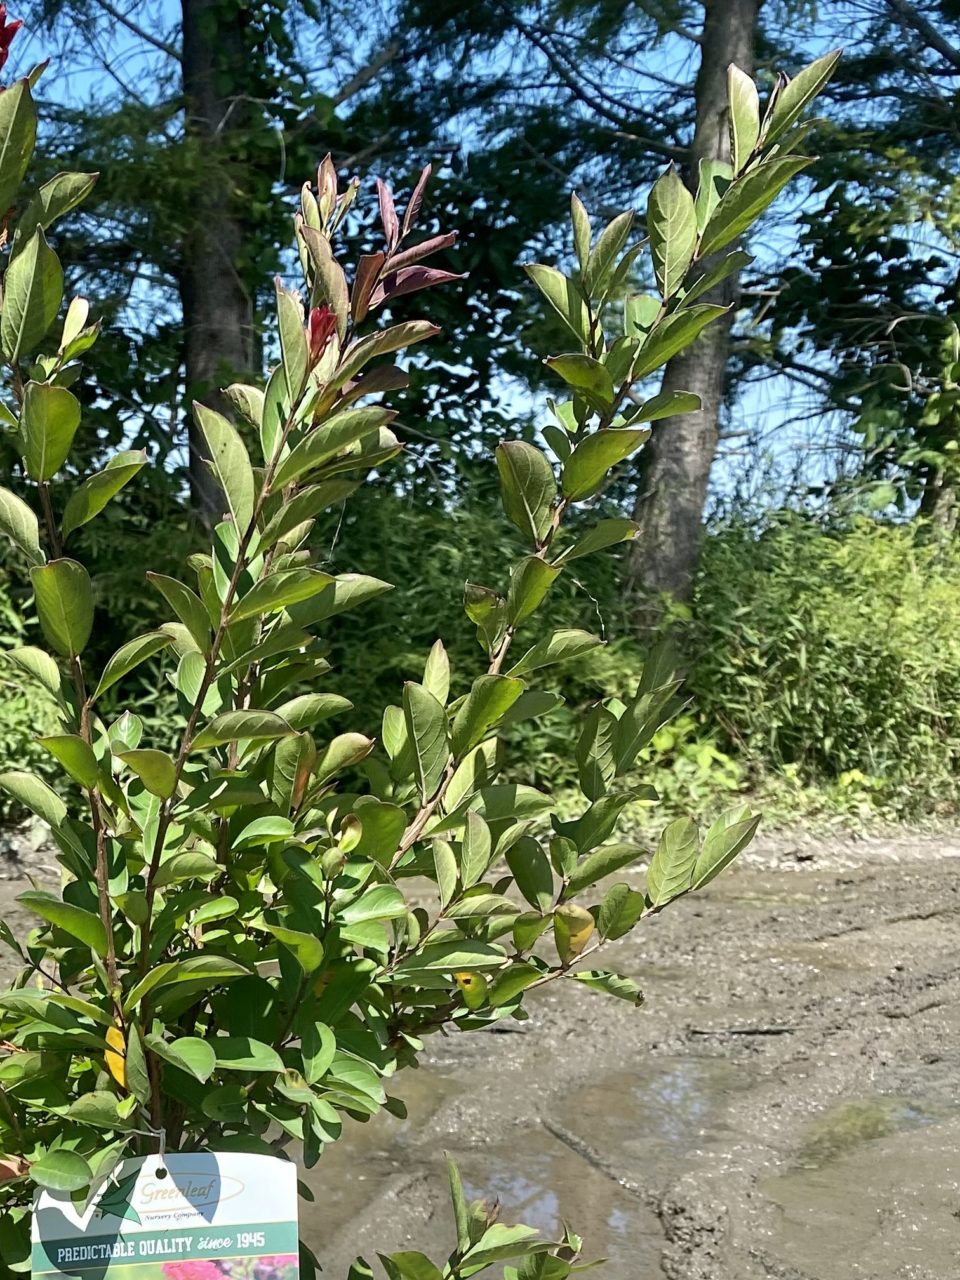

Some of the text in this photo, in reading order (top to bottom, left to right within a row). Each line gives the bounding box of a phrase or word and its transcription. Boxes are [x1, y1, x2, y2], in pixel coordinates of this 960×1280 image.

[140, 1179, 216, 1205] Greenleaf
[144, 1211, 204, 1221] Nursery Company
[57, 1231, 266, 1263] PREDICTABLE QUALITY since 1945
